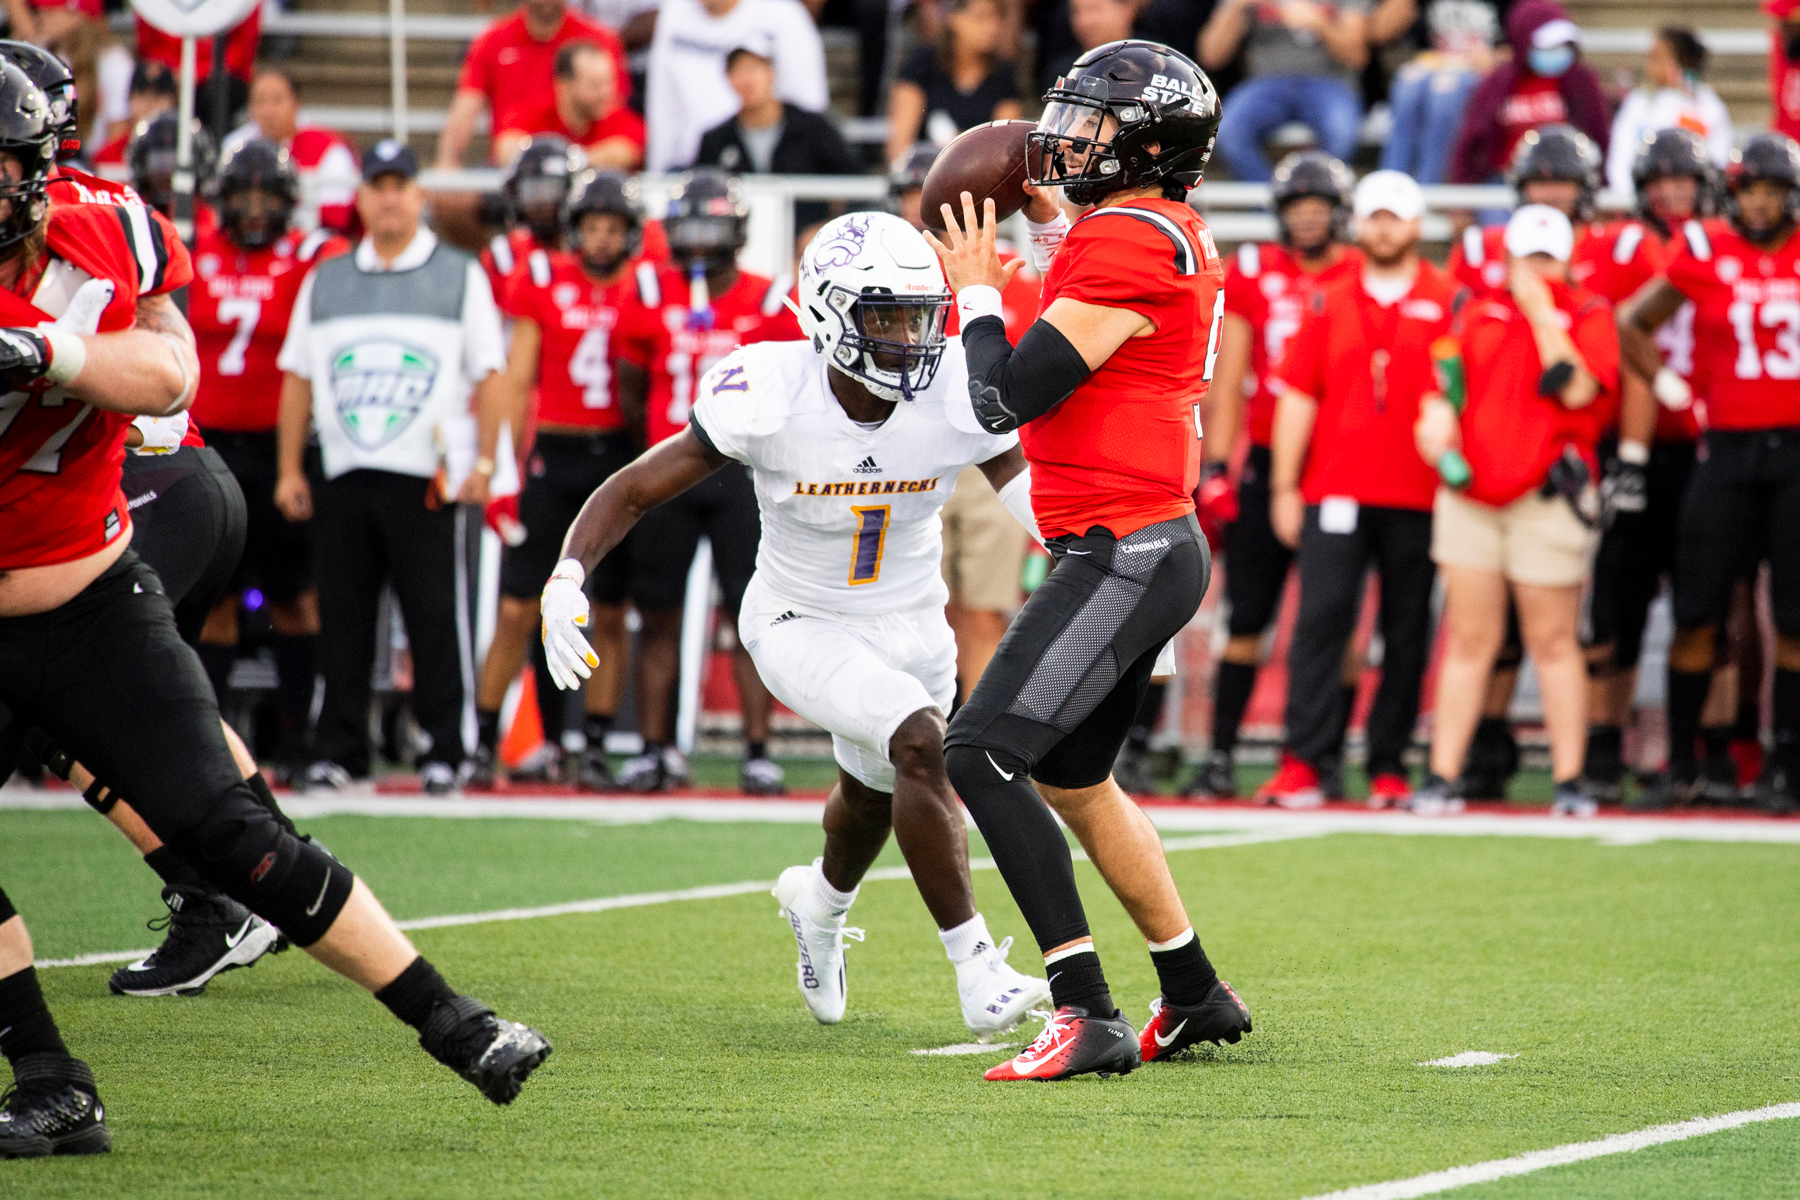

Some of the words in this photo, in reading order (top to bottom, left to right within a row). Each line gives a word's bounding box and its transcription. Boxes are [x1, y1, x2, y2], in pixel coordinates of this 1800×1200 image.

[1141, 86, 1205, 116] STATE
[1150, 73, 1202, 101] BALL
[216, 299, 261, 376] 7
[1727, 300, 1800, 380] 13
[568, 324, 612, 409] 4
[793, 476, 943, 496] LEATHERNECKS
[853, 466, 882, 474] adidas
[848, 504, 891, 586] 1
[1121, 537, 1170, 554] CARDINALS
[788, 908, 820, 990] ADIZERO
